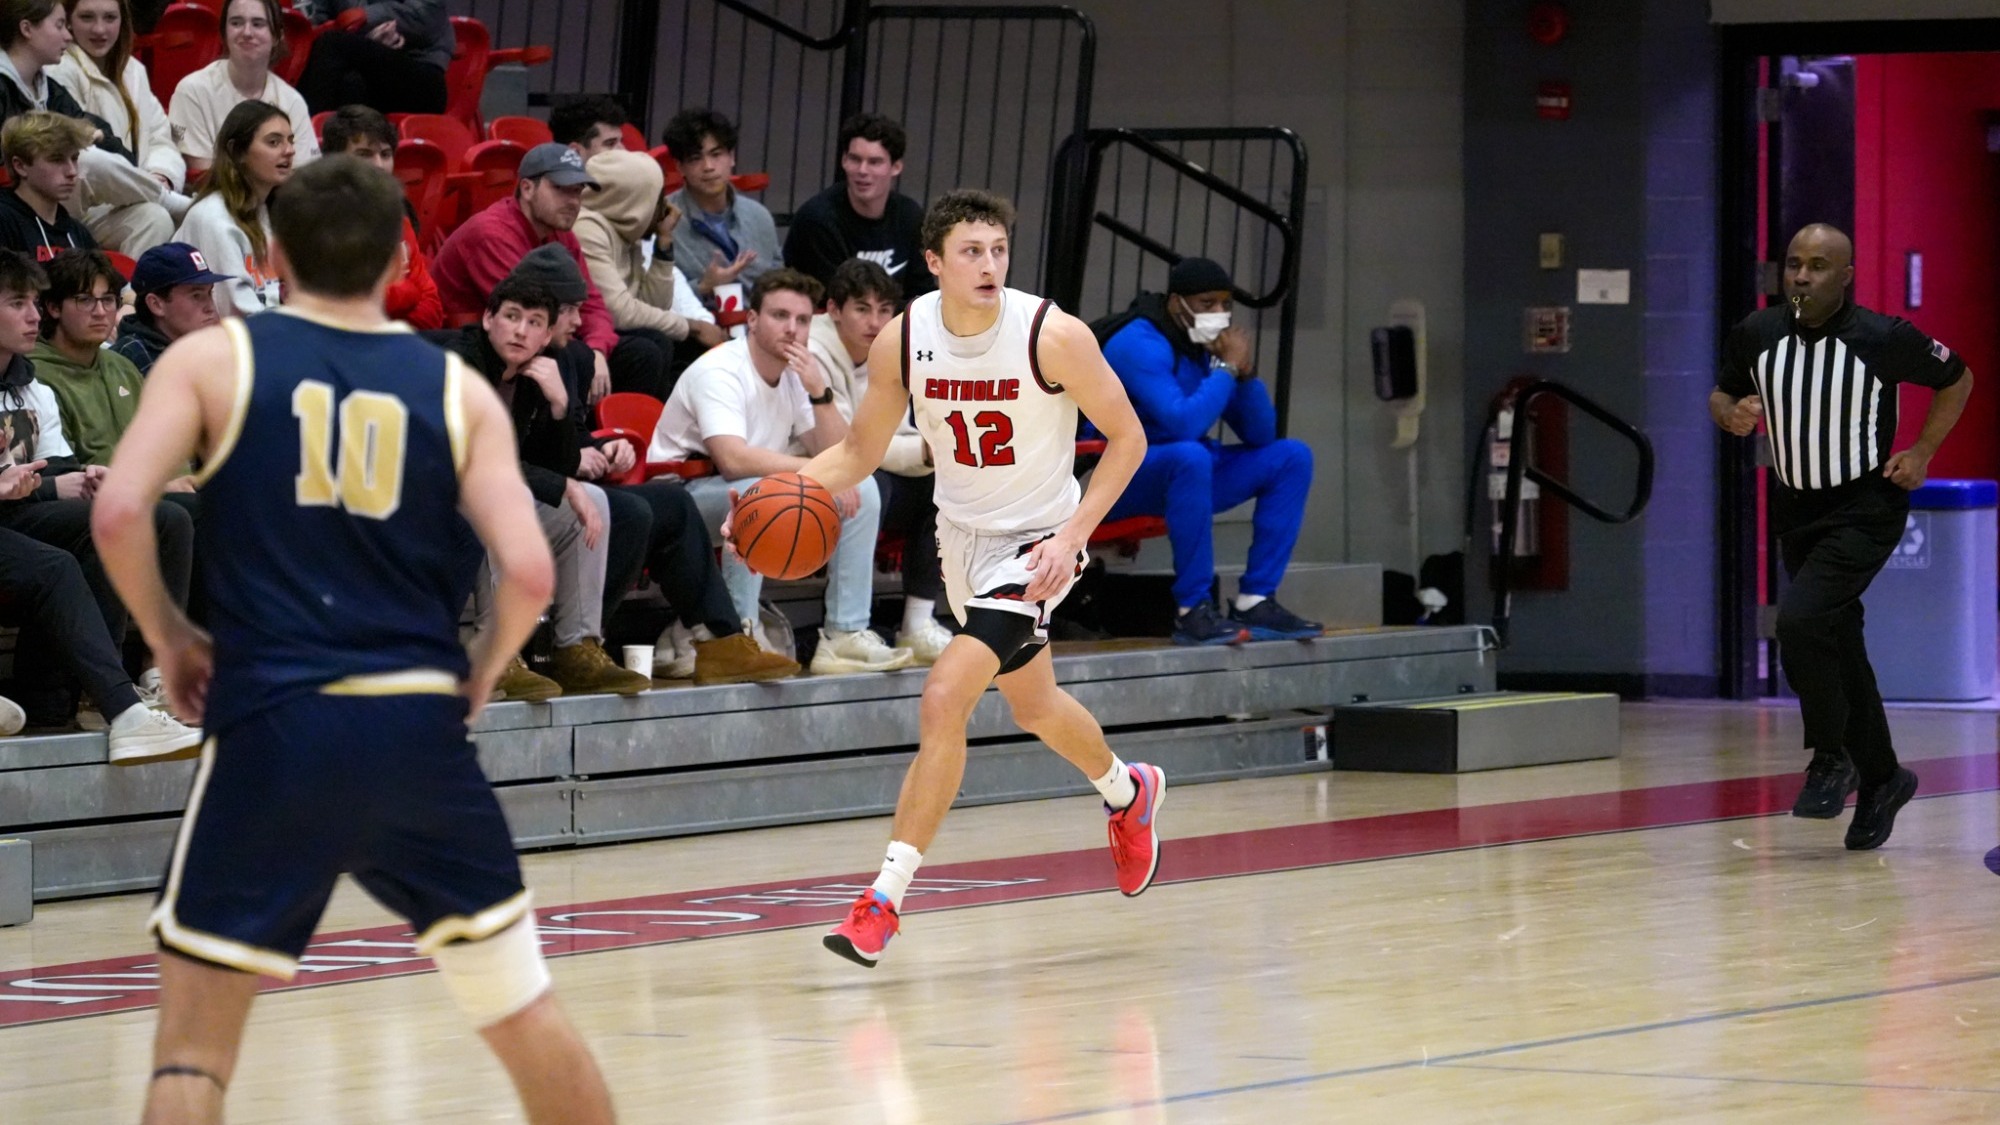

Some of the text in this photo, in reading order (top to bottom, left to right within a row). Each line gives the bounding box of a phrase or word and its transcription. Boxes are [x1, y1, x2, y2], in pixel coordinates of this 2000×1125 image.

[925, 378, 1020, 401] CATHOLIC
[292, 378, 409, 520] 10
[944, 410, 1016, 469] 12
